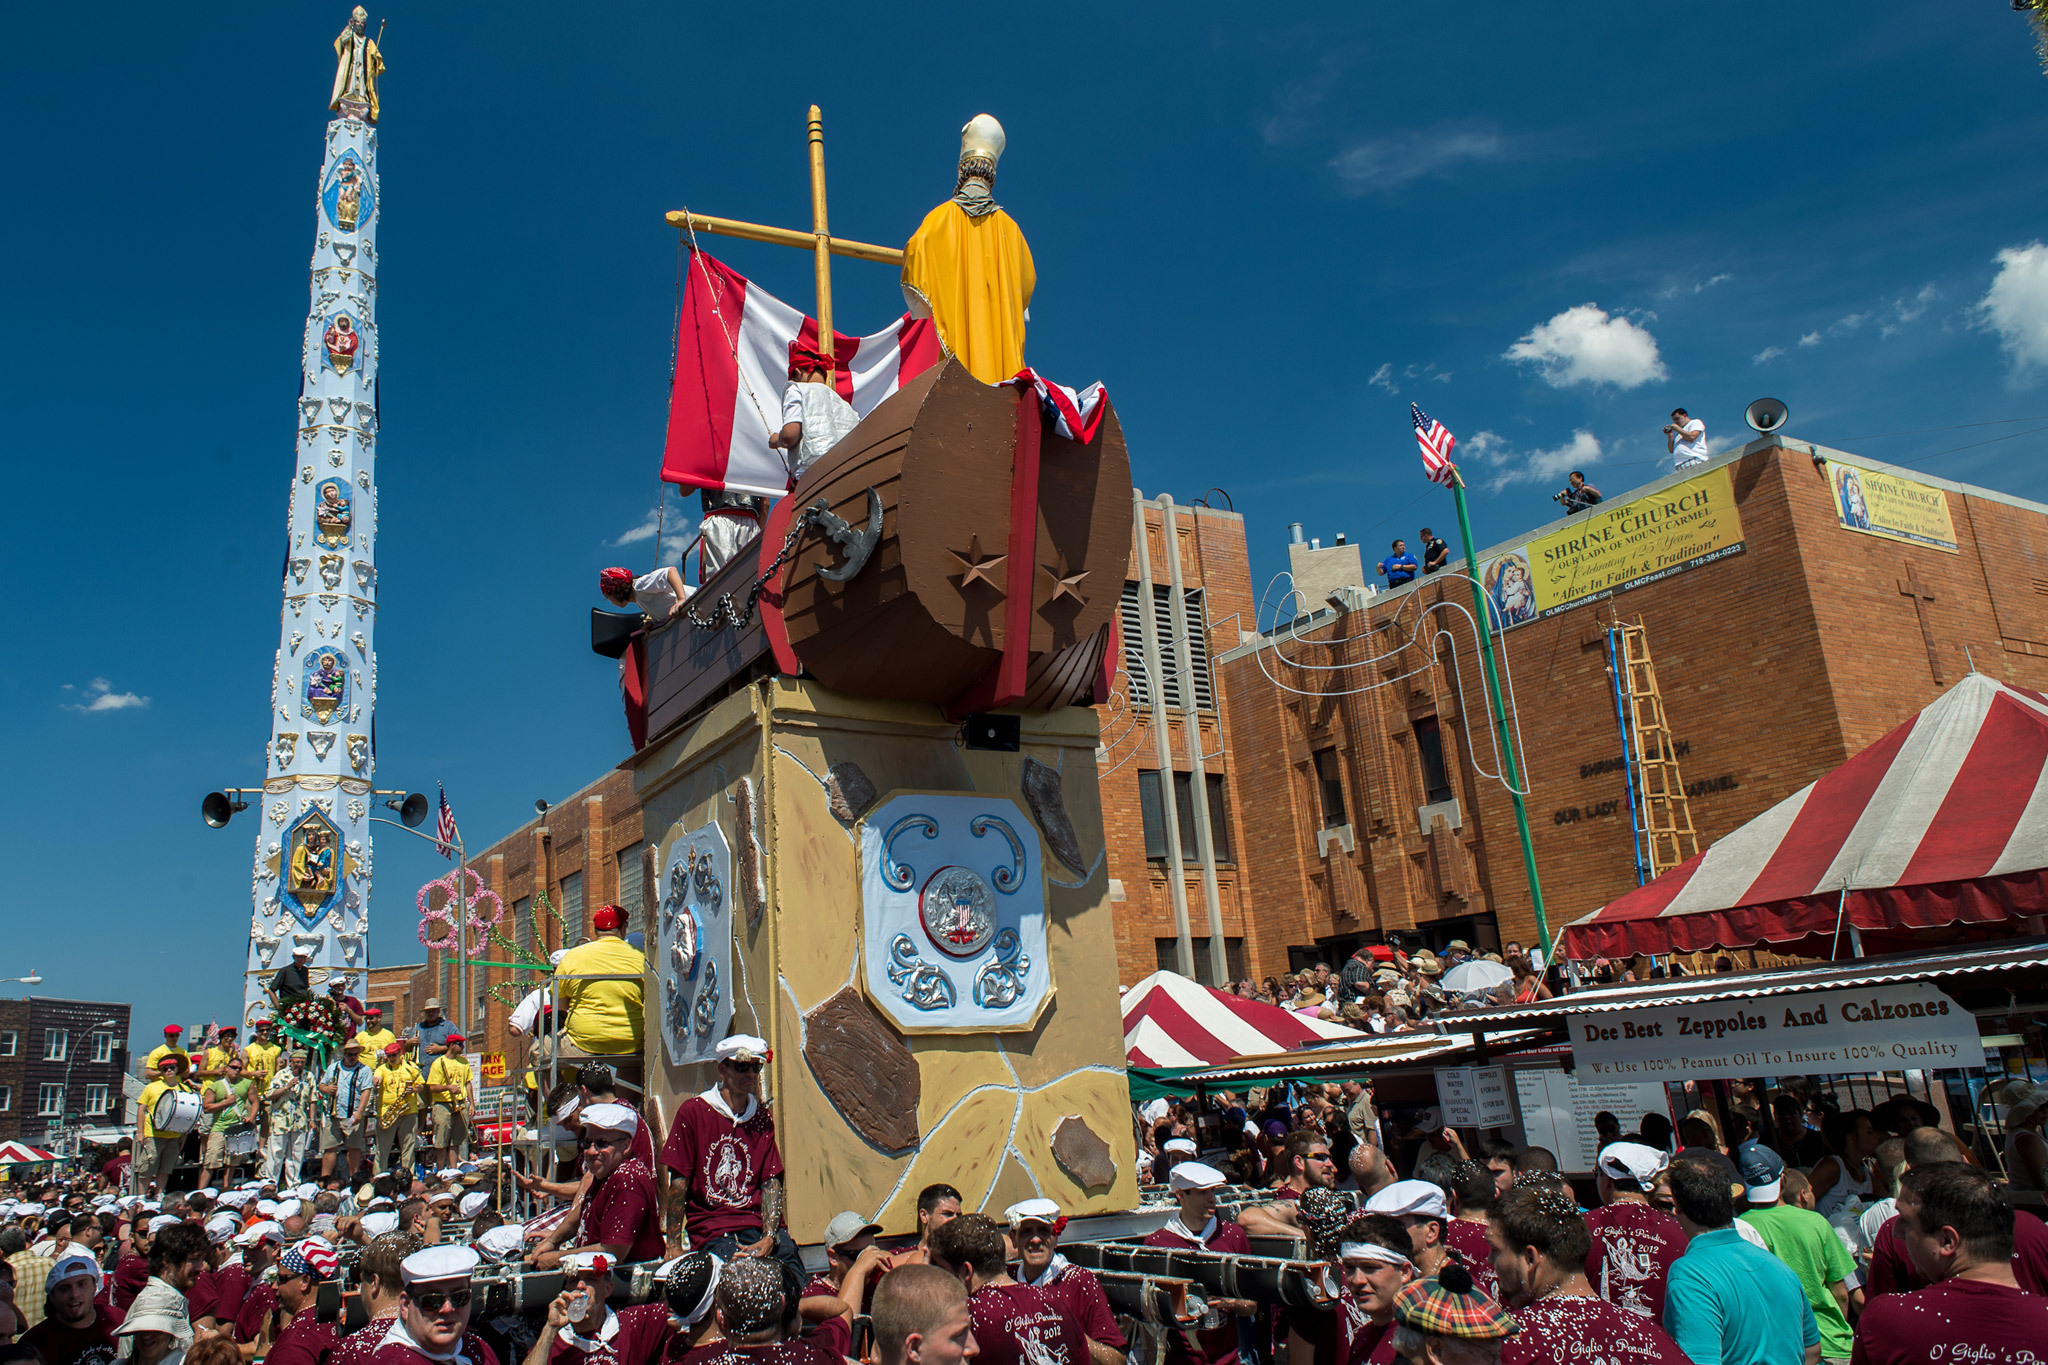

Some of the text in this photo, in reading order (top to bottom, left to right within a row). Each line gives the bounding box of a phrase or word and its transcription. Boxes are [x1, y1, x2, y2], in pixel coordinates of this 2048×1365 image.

[1865, 479, 1939, 507] SHRINE CHURCH
[1544, 489, 1709, 563] SHRINE CHURCH
[1608, 507, 1633, 522] THE
[1900, 519, 1913, 531] Faith
[1547, 508, 1712, 575] of OUR LADY OF MOUNT CARMEL
[1571, 531, 1693, 579] Celebrating 125 Years
[1545, 544, 1741, 616] OLMCChurchBK.com OLMCFeast.com 718-384-0223
[1553, 534, 1720, 602] "Alive In Faith & Tradition"
[1580, 756, 1626, 779] SHRINE
[1554, 807, 1581, 826] OUR
[1585, 800, 1618, 819] LADY
[1683, 774, 1739, 798] CARMEL
[1584, 999, 1950, 1042] Dee Best Zeppoles And Calzones
[1591, 1041, 1958, 1074] We Use 100% Peanut Oil To Insure 100% Quality
[720, 1133, 733, 1143] Lady
[1604, 1225, 1627, 1238] Giglio
[1635, 1228, 1667, 1245] Paradiso
[1637, 1244, 1660, 1254] 2012
[1044, 1325, 1061, 1340] 2012
[1570, 1337, 1603, 1360] Giglio
[1615, 1338, 1662, 1360] Paradiso
[1952, 1343, 1996, 1364] Giglio
